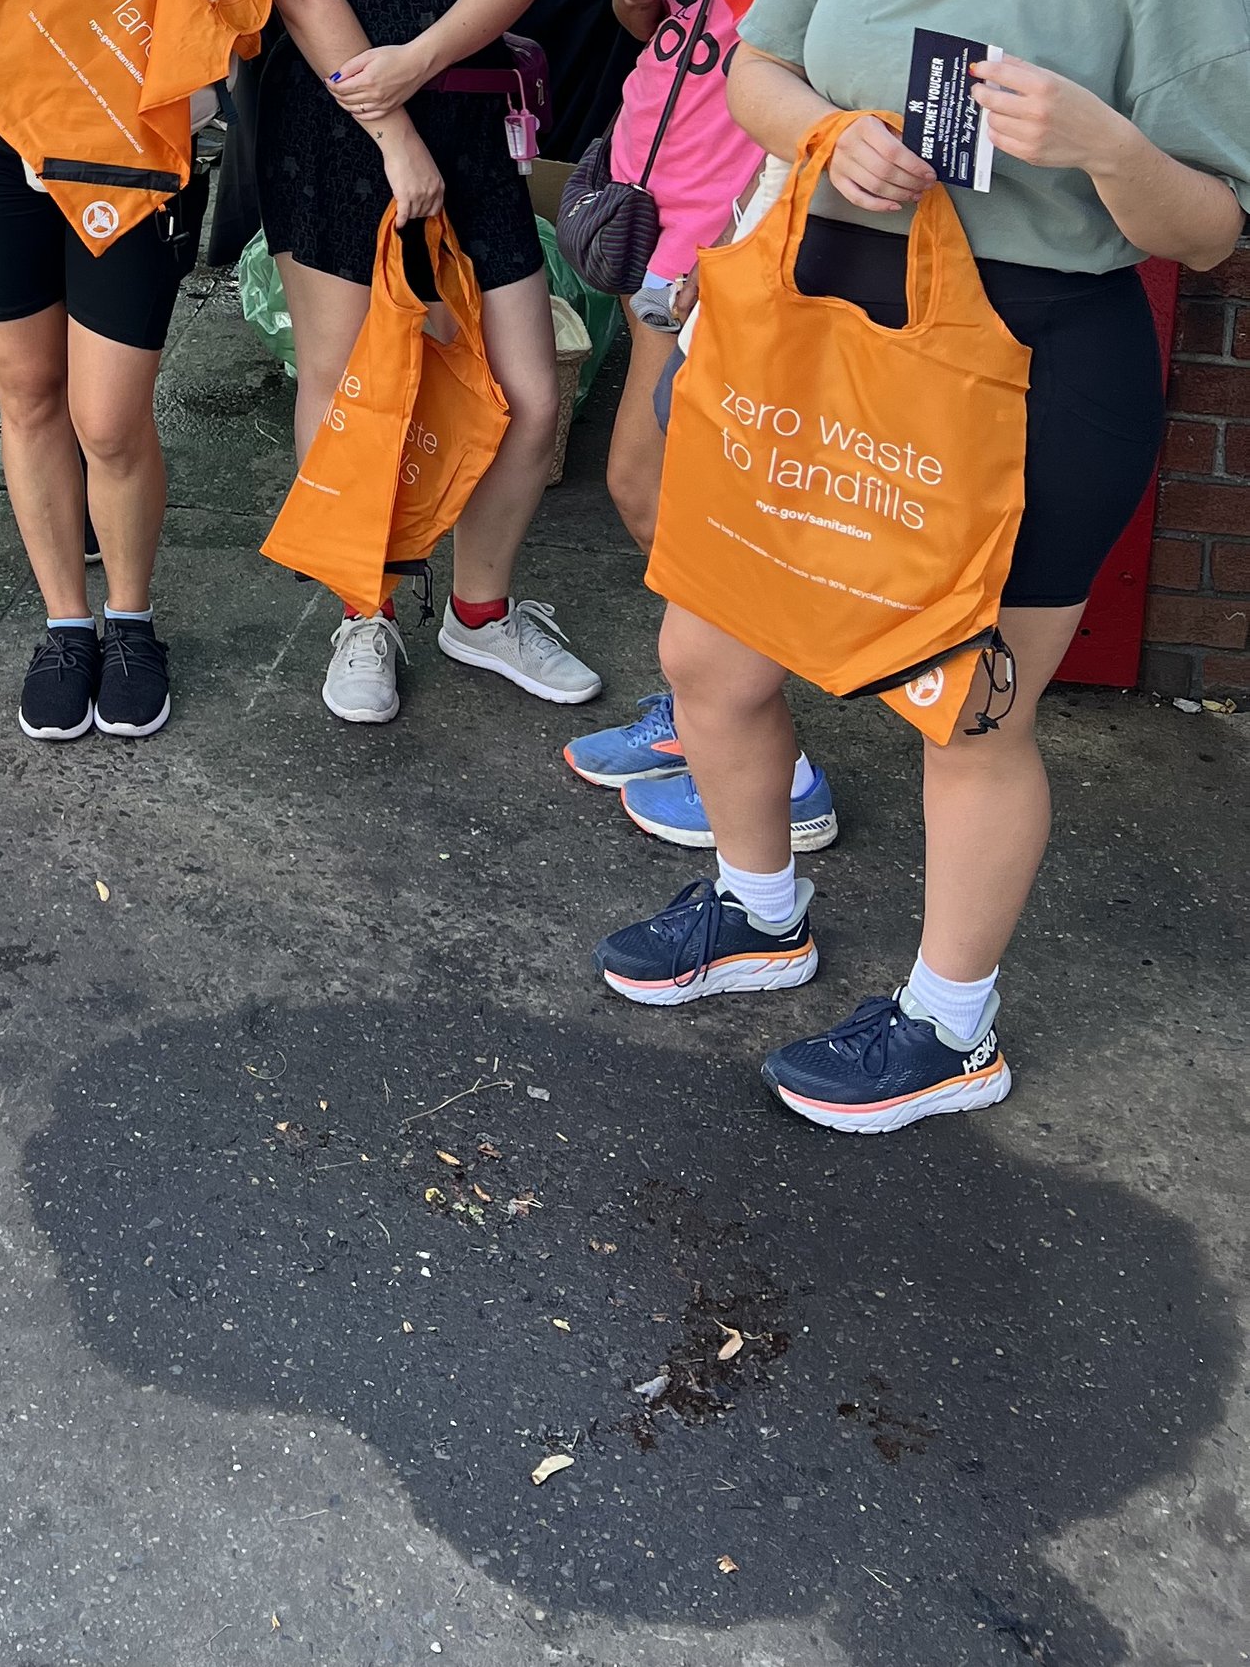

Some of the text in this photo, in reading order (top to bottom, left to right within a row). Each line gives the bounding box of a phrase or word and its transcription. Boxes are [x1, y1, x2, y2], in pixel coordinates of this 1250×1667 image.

[89, 19, 144, 86] nyc.gov/sanitatio
[921, 55, 943, 161] 2022 TICKET VOUCHER
[963, 112, 976, 132] York
[720, 382, 942, 485] zero waste
[720, 427, 925, 530] to landfills
[756, 499, 872, 542] nyc.gov/sanitation
[808, 572, 828, 584] with
[827, 578, 847, 591] 90%
[847, 586, 883, 603] recycled
[962, 1029, 997, 1074] HOKA
